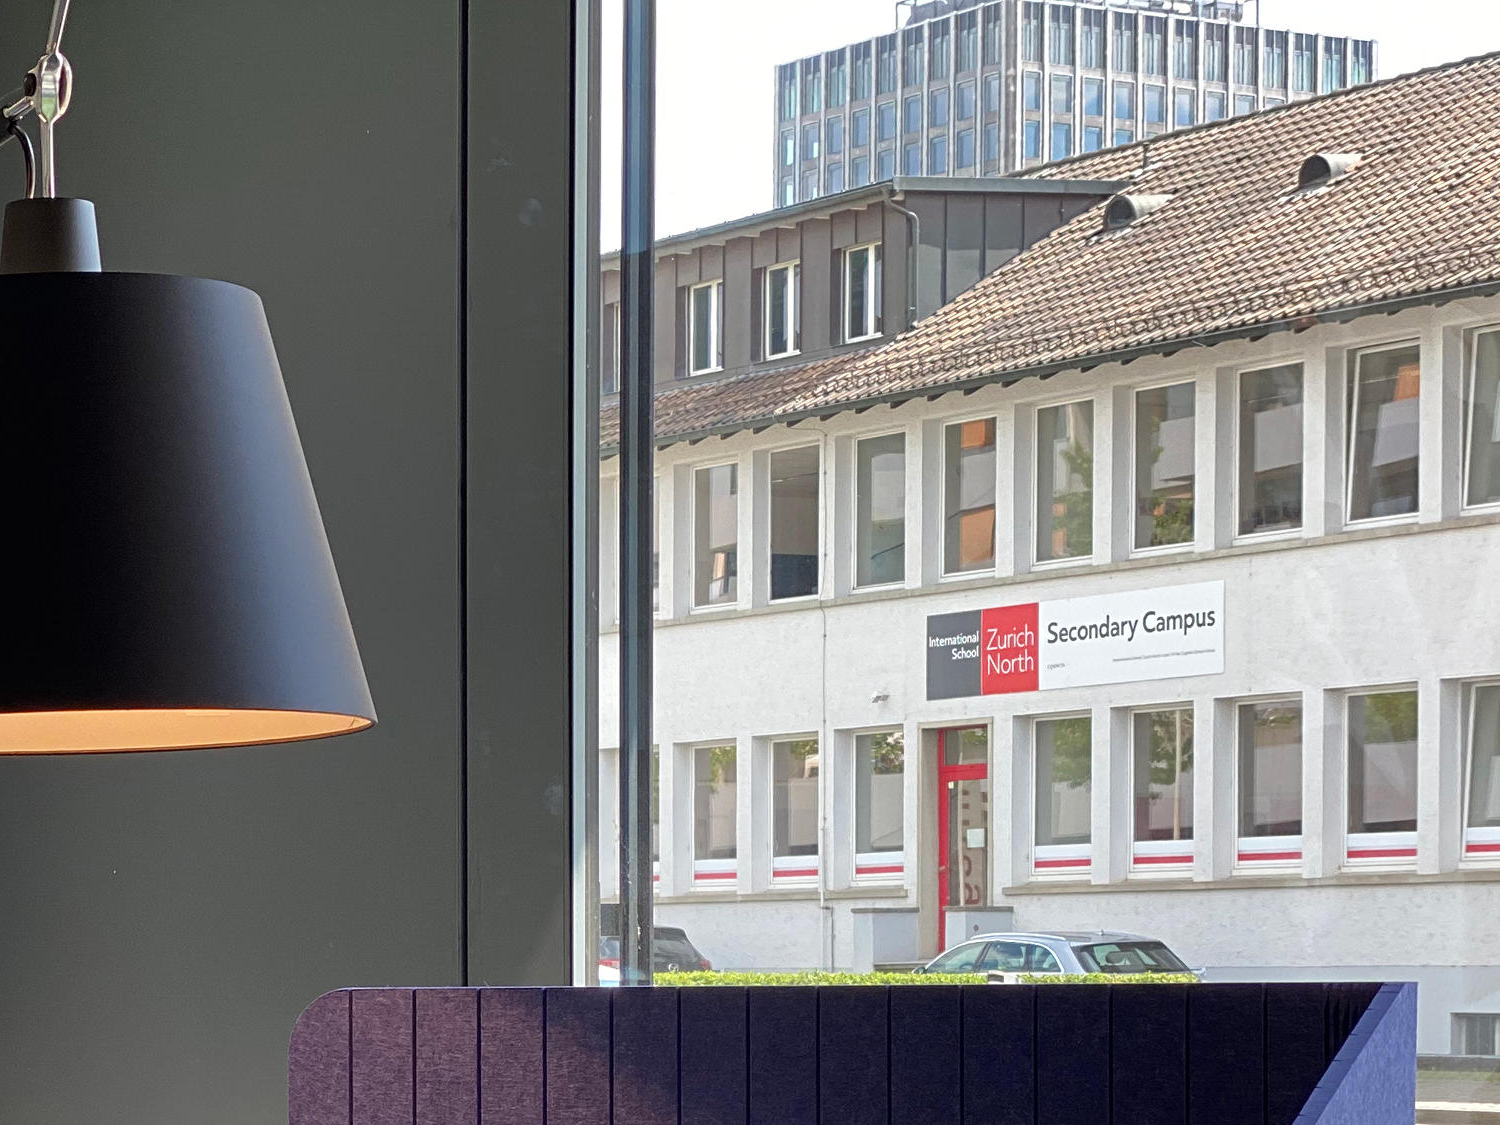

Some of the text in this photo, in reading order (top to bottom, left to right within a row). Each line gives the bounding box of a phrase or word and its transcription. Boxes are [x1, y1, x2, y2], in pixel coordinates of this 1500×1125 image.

[928, 630, 980, 648] International
[986, 623, 1035, 651] Zurich
[1047, 610, 1216, 644] Secondary Campus
[951, 645, 980, 660] School
[987, 648, 1034, 676] North
